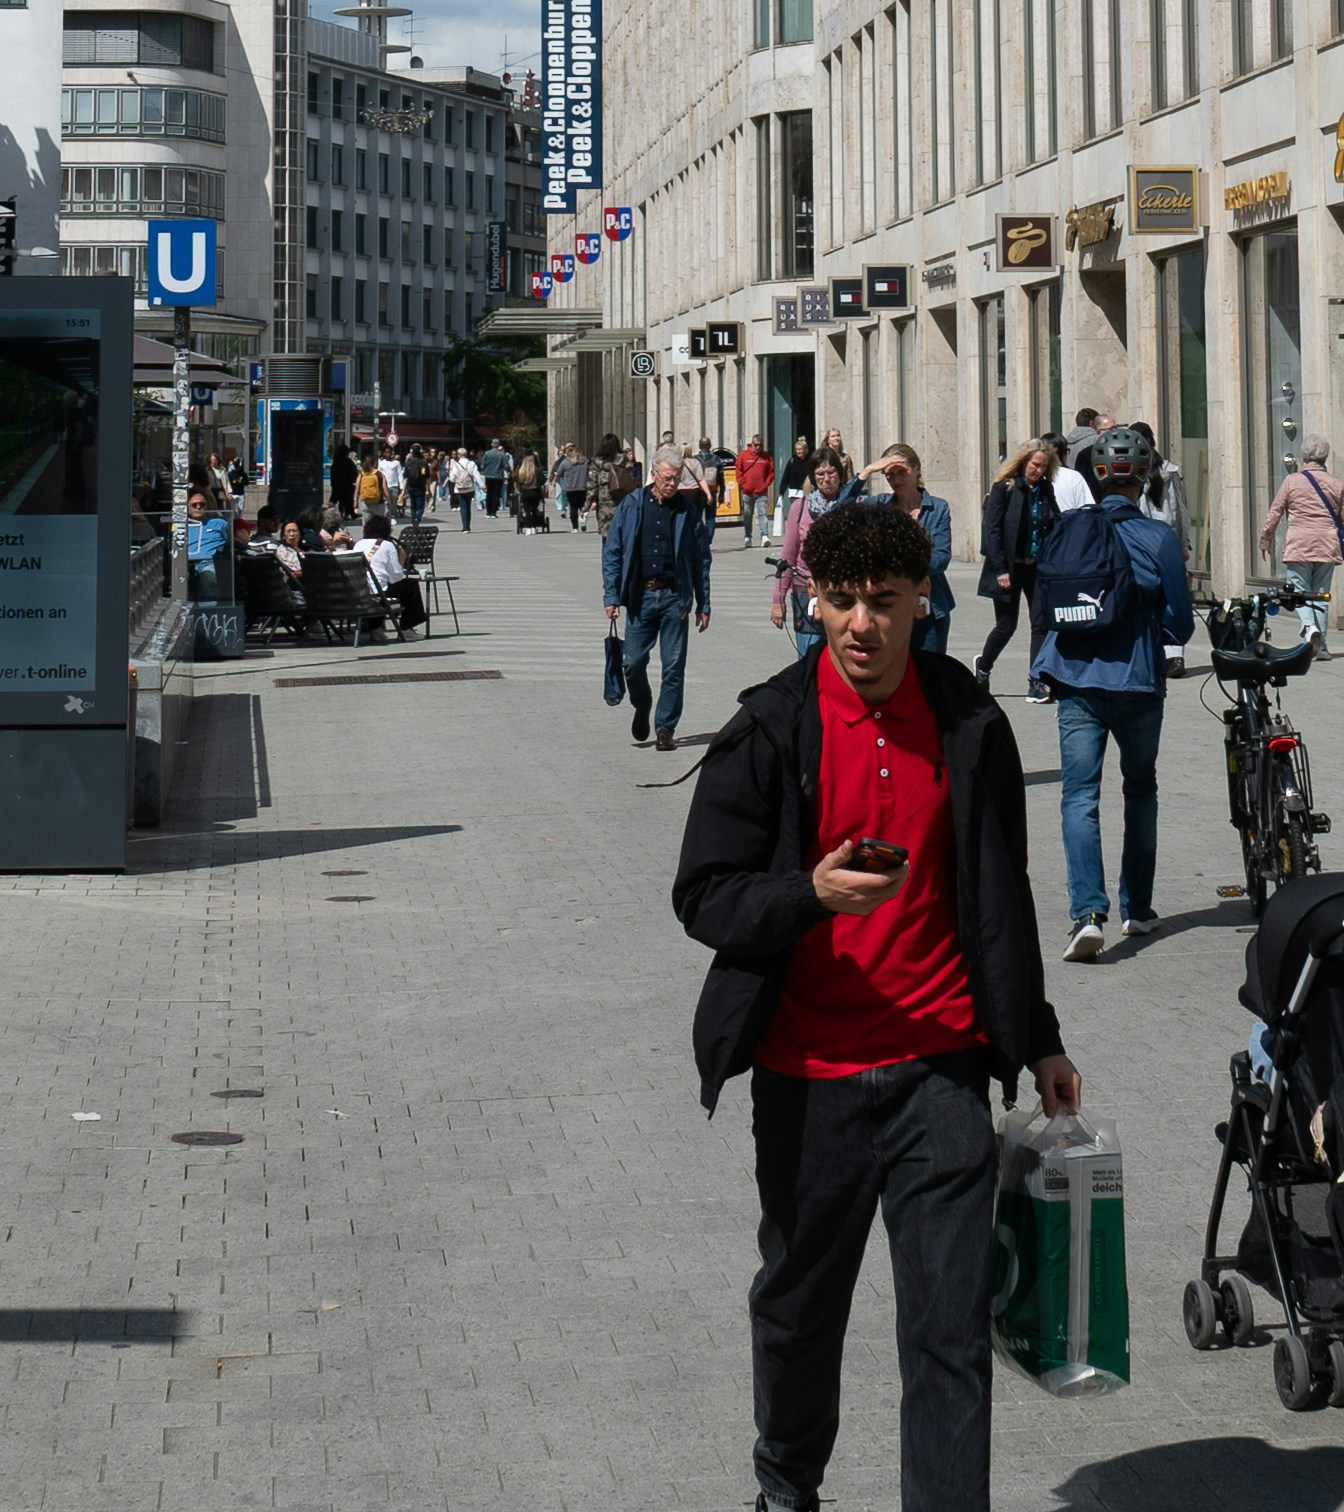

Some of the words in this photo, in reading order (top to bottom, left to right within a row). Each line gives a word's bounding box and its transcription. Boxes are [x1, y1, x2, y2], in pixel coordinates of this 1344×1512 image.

[1138, 185, 1192, 209] Eckerle
[606, 213, 630, 230] P&C
[577, 239, 599, 254] P&C
[157, 232, 206, 293] U
[491, 224, 501, 288] Hugendubel
[553, 260, 573, 273] P&C
[532, 277, 551, 289] P&C
[65, 319, 91, 328] 15:51
[48, 608, 67, 619] an
[1054, 605, 1097, 623] PUMA
